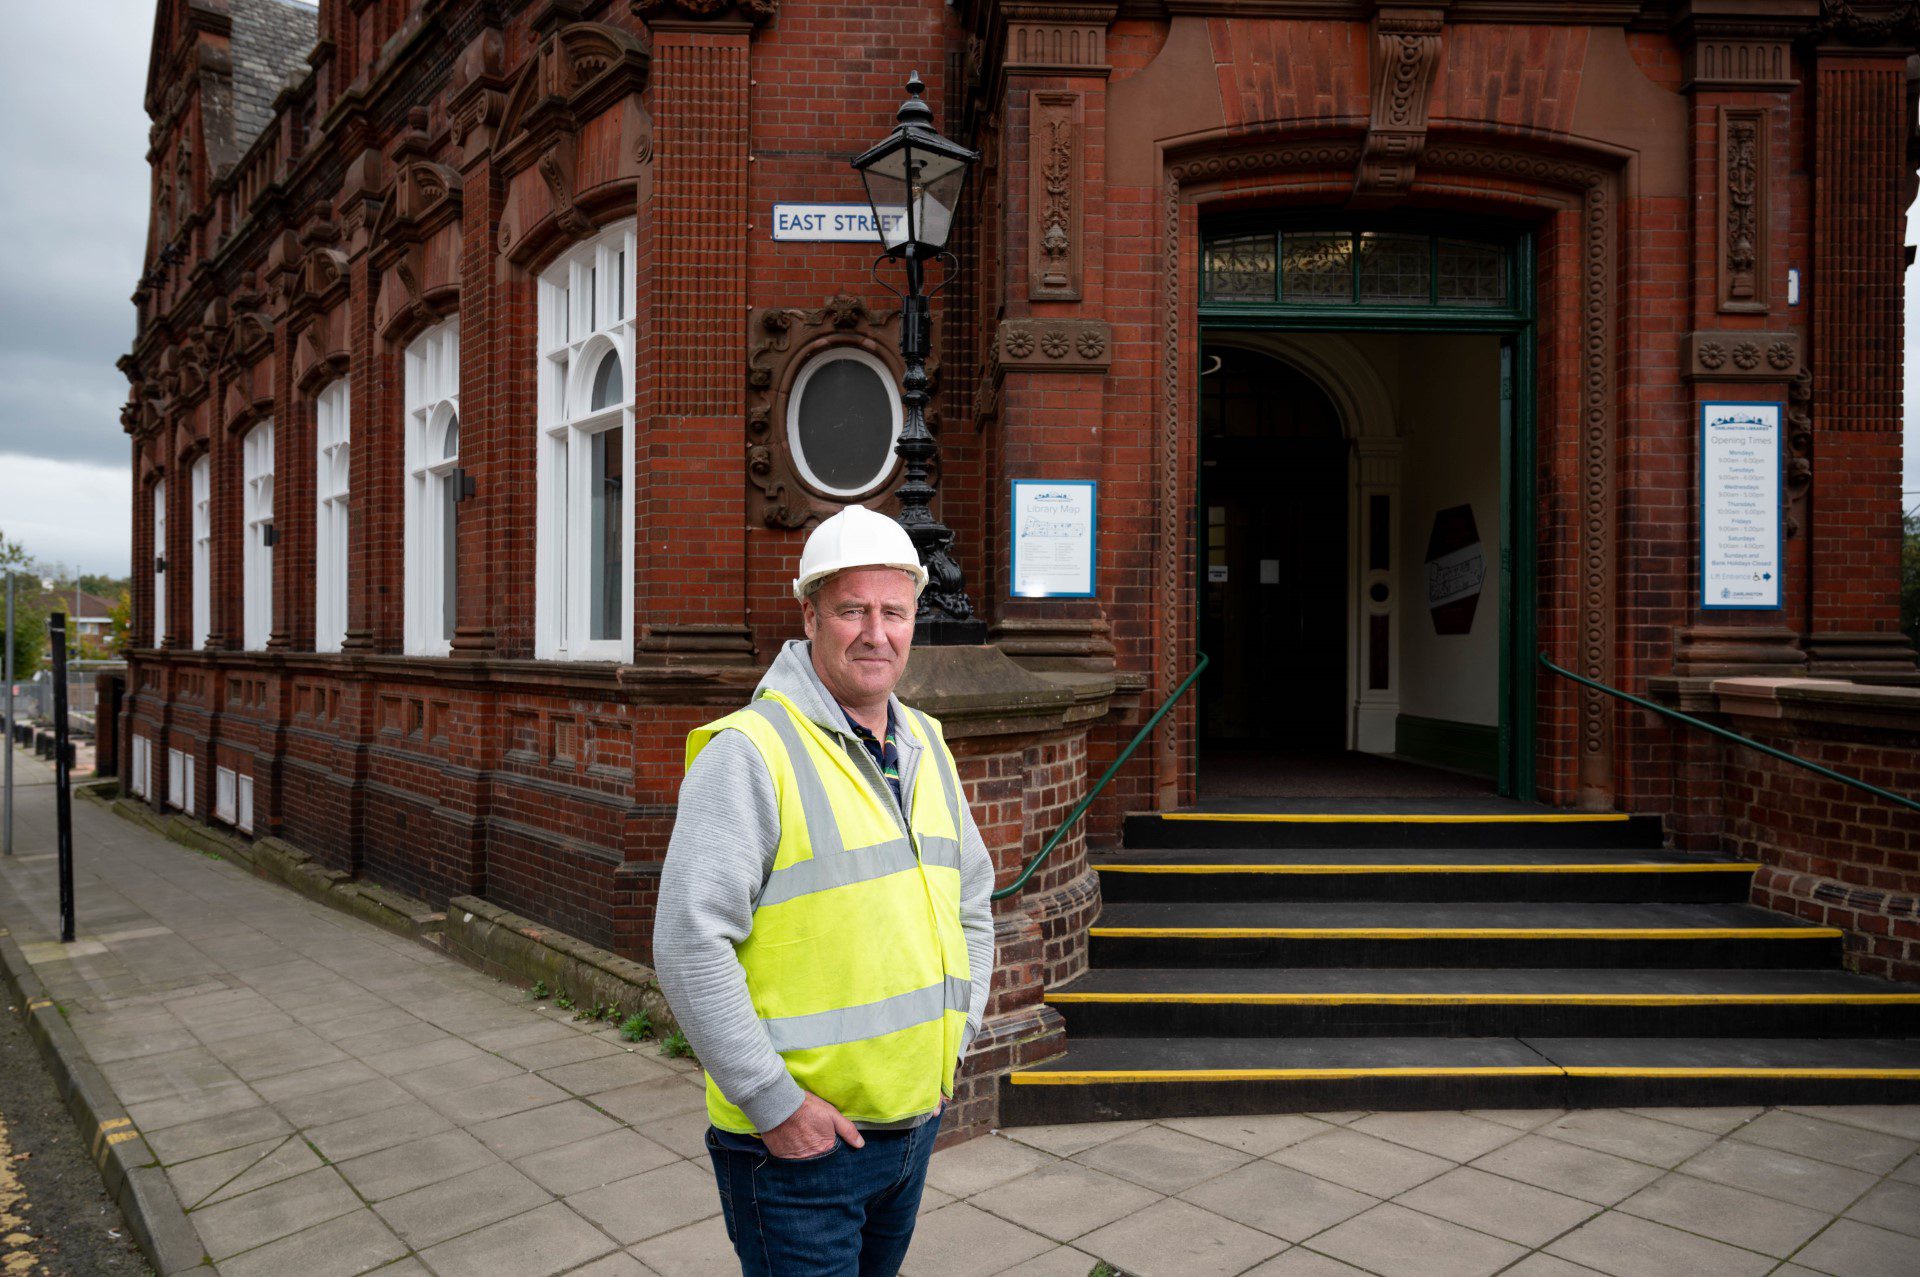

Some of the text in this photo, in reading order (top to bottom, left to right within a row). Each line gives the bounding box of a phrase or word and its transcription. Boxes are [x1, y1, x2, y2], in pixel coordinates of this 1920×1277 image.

[779, 214, 903, 231] EAST STREET
[1711, 436, 1772, 446] Opening Times
[1027, 504, 1080, 516] Library Map
